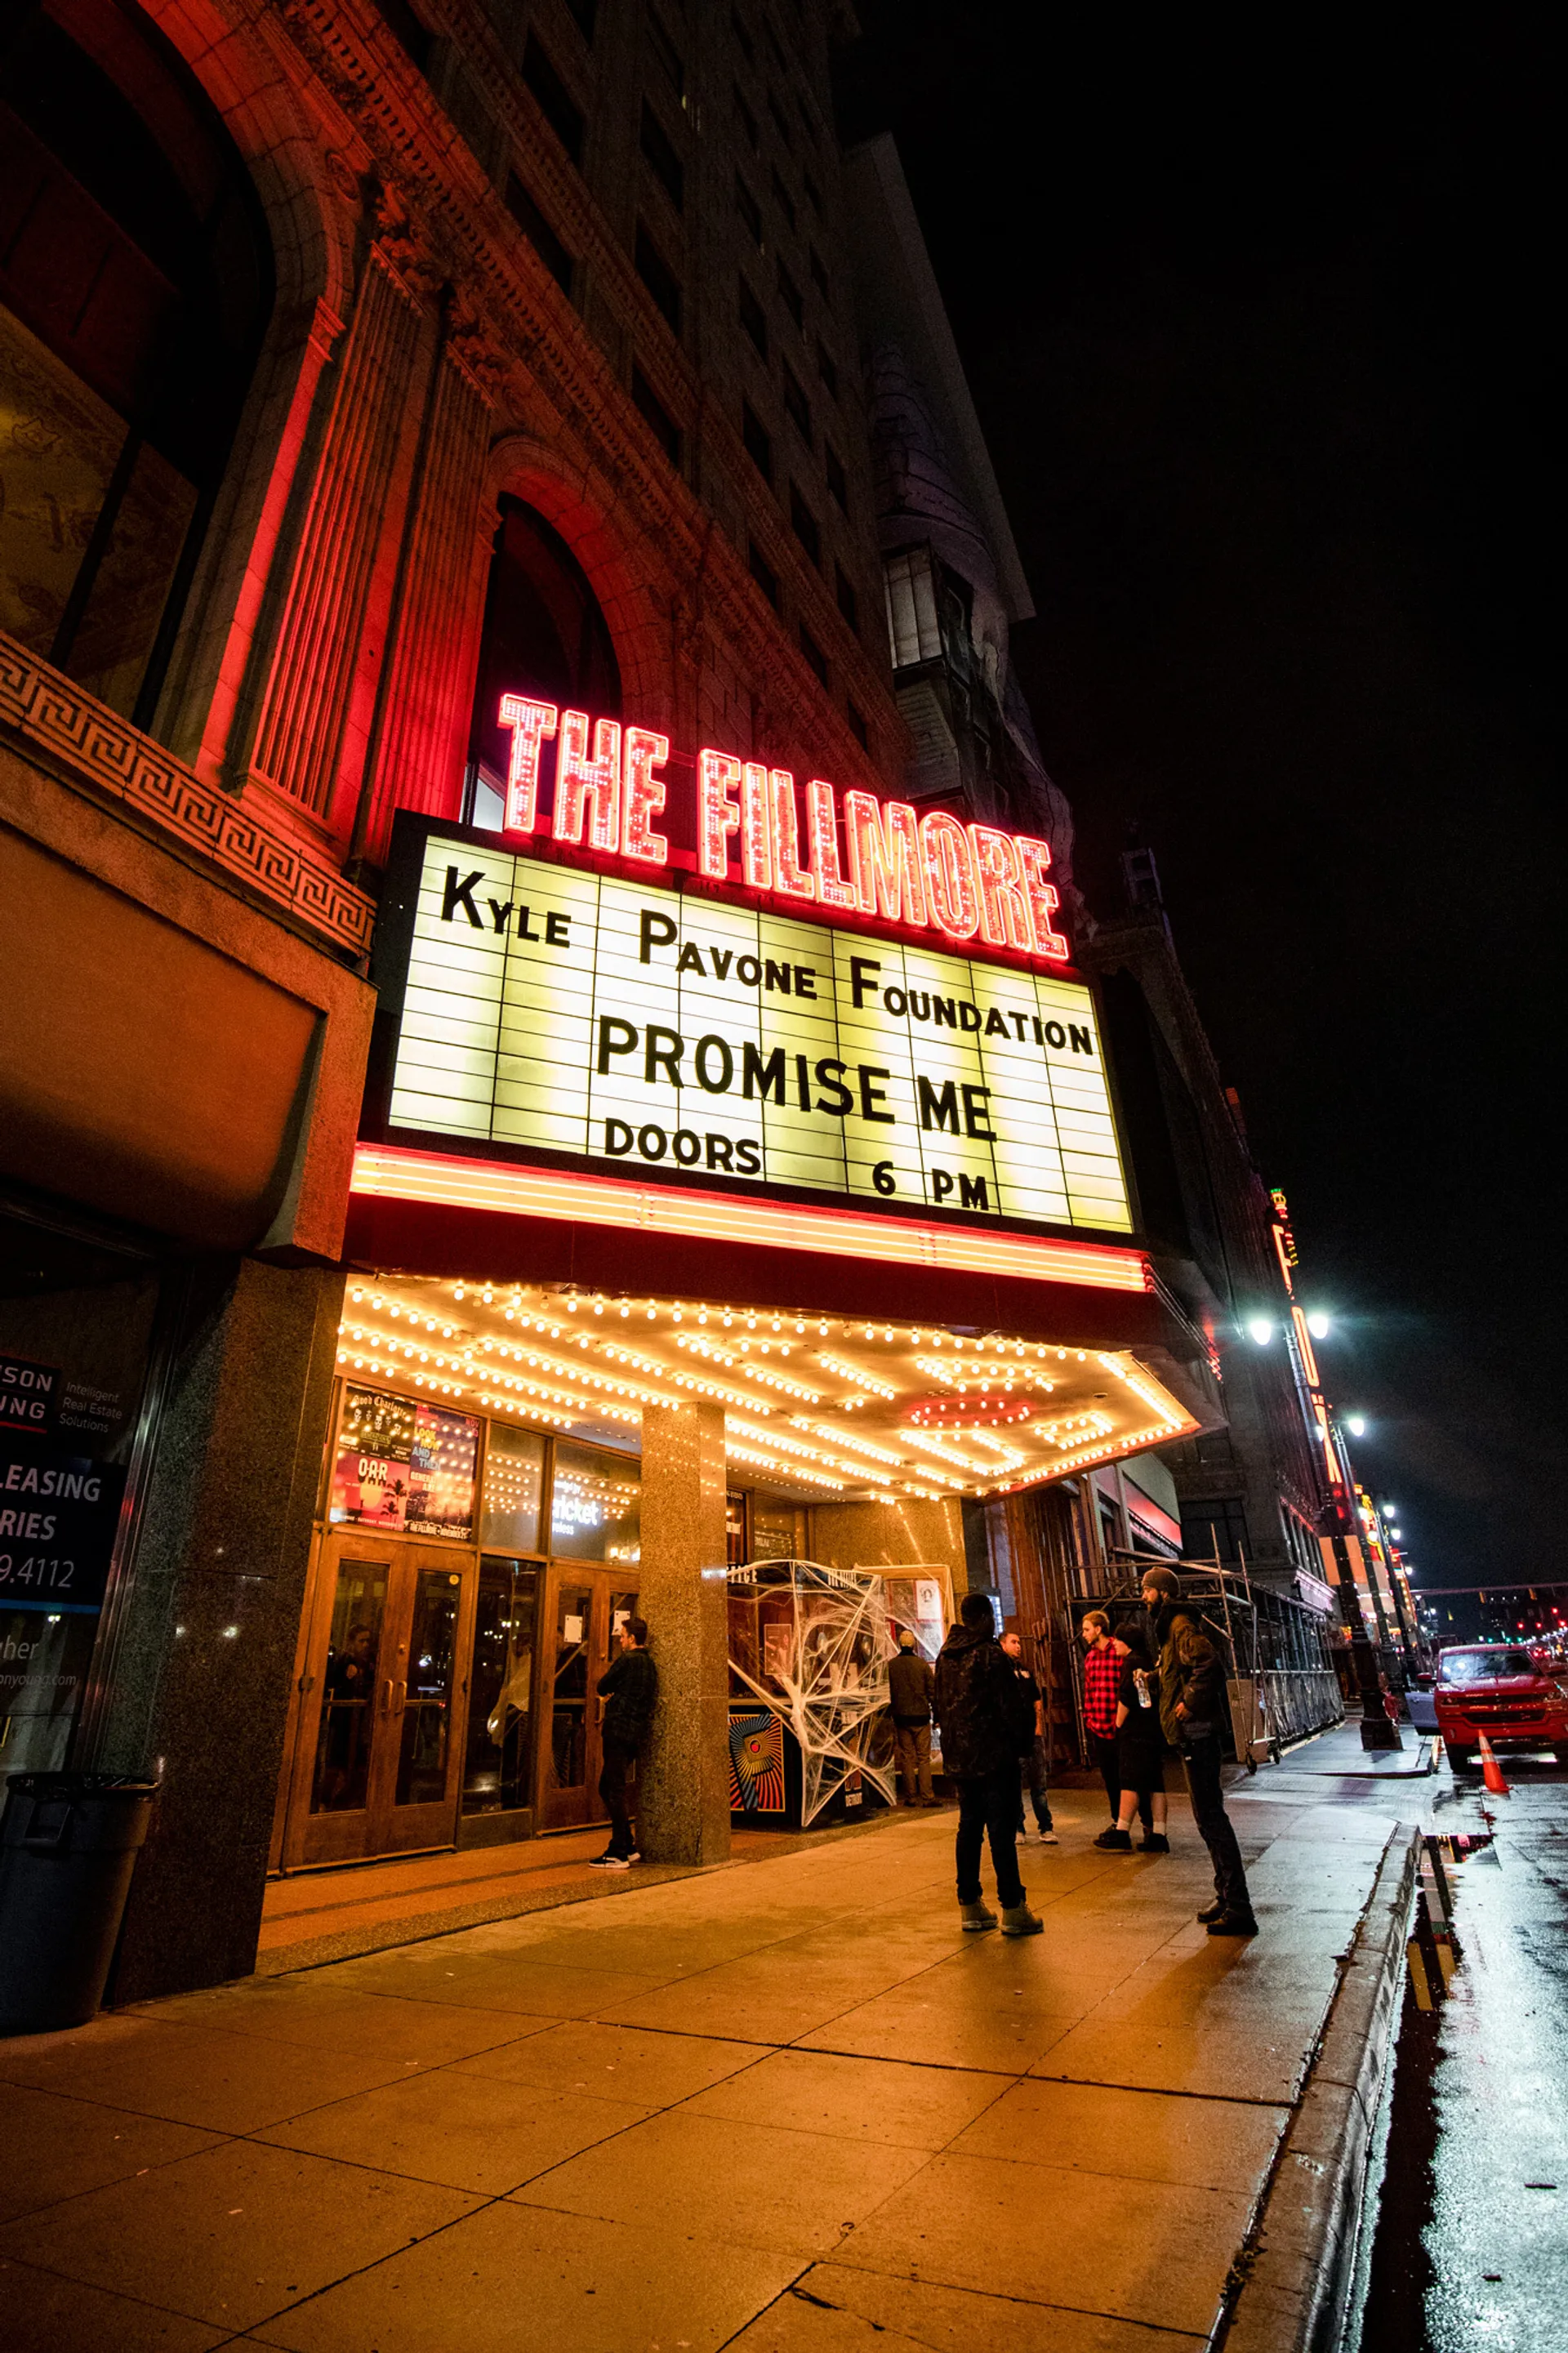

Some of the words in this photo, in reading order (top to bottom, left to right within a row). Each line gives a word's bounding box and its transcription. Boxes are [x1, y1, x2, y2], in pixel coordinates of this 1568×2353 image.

[497, 693, 670, 864] THE
[697, 747, 1071, 961] FILLMORE
[440, 865, 572, 948] KYLE
[639, 909, 817, 1000] PAVONE
[850, 956, 1094, 1056] FOUNDATION
[597, 1014, 897, 1124] PROMISE
[916, 1074, 998, 1142] ME
[604, 1116, 762, 1175] DOORS
[871, 1161, 897, 1196] 6
[932, 1168, 989, 1212] PM
[0, 1365, 53, 1393] SON
[65, 1381, 121, 1403] Intelligent
[62, 1397, 87, 1411] Real
[89, 1402, 123, 1420] Estate
[59, 1413, 109, 1433] Solutions
[414, 1426, 436, 1440] LOOK
[412, 1446, 430, 1458] AND
[0, 1463, 102, 1502] EASING
[0, 1634, 40, 1660] her
